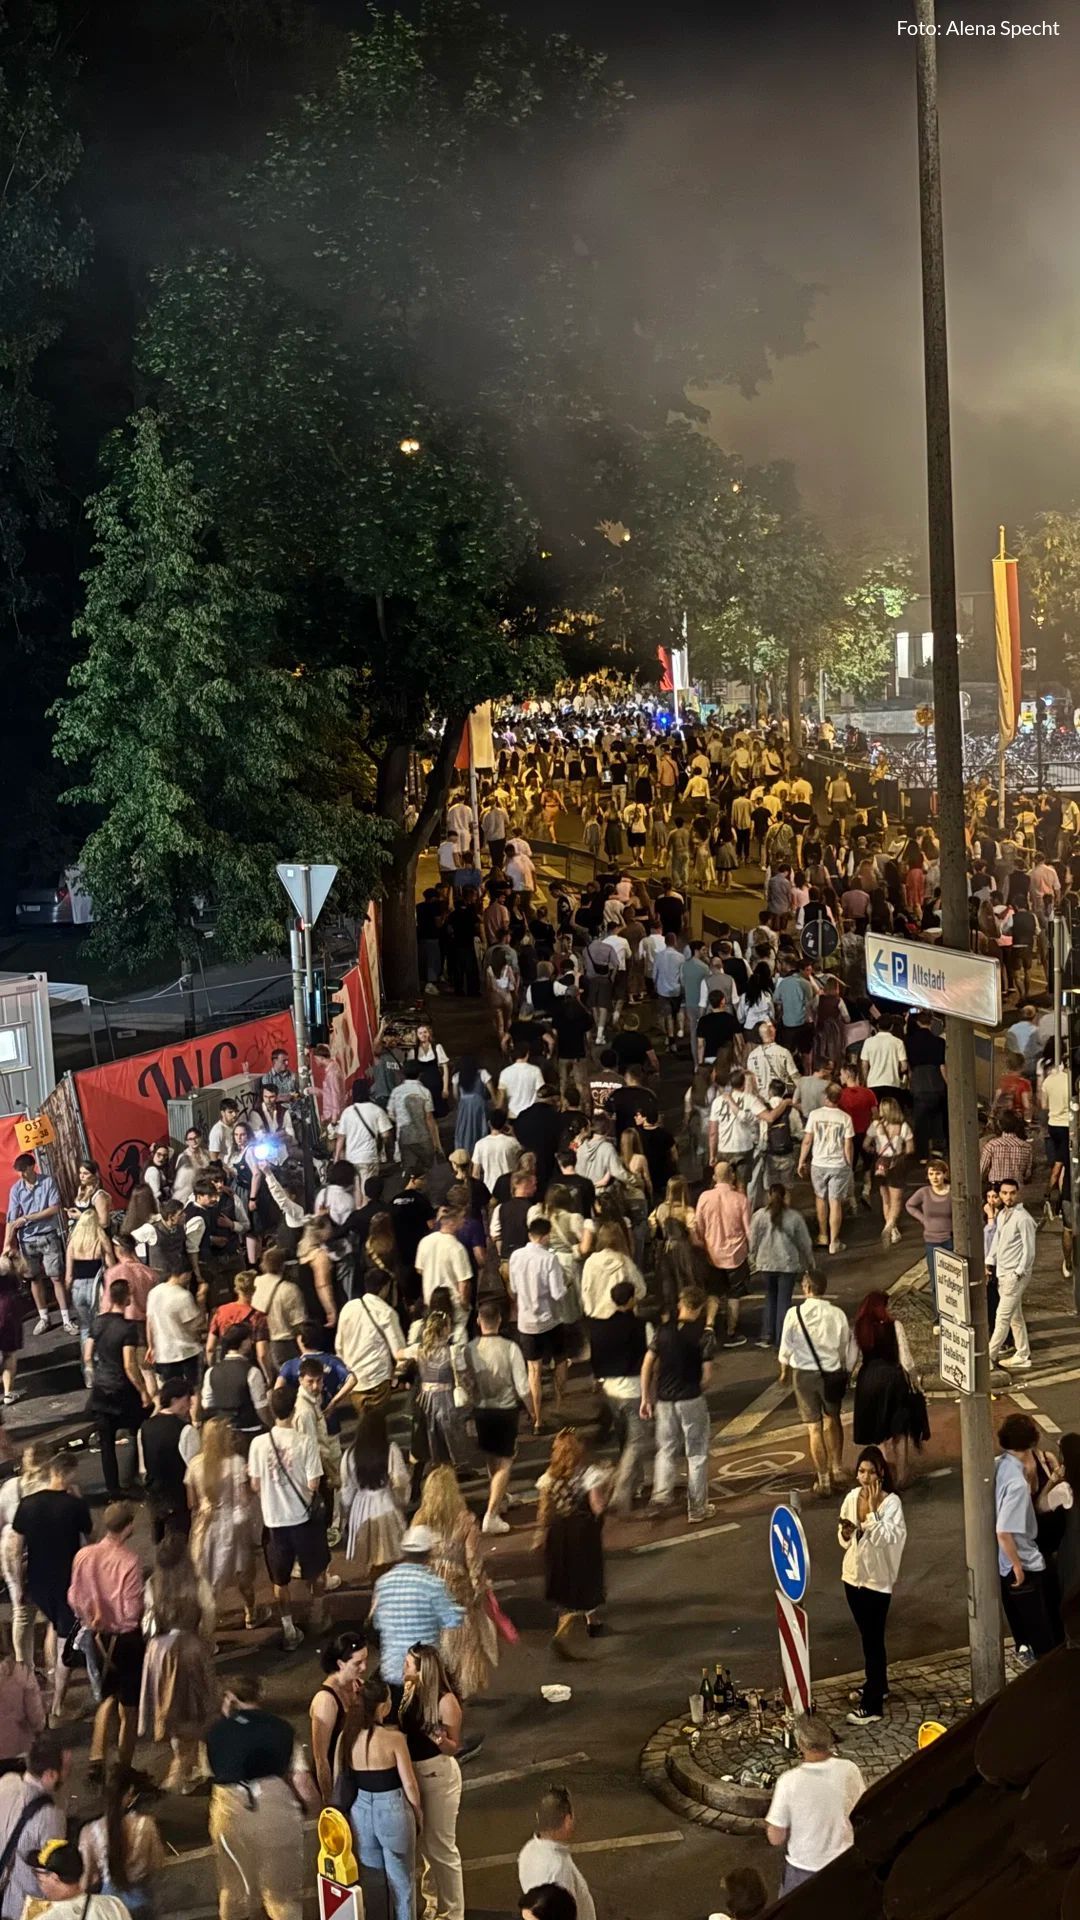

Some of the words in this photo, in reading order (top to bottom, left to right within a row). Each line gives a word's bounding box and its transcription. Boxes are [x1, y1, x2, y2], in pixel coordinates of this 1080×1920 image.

[895, 956, 905, 983] P
[912, 963, 946, 991] Altstadt
[138, 1042, 238, 1112] WC
[24, 1120, 42, 1132] OST
[24, 1135, 31, 1144] 2
[941, 1325, 952, 1341] Bitte
[952, 1331, 960, 1345] bis
[961, 1337, 970, 1349] zur
